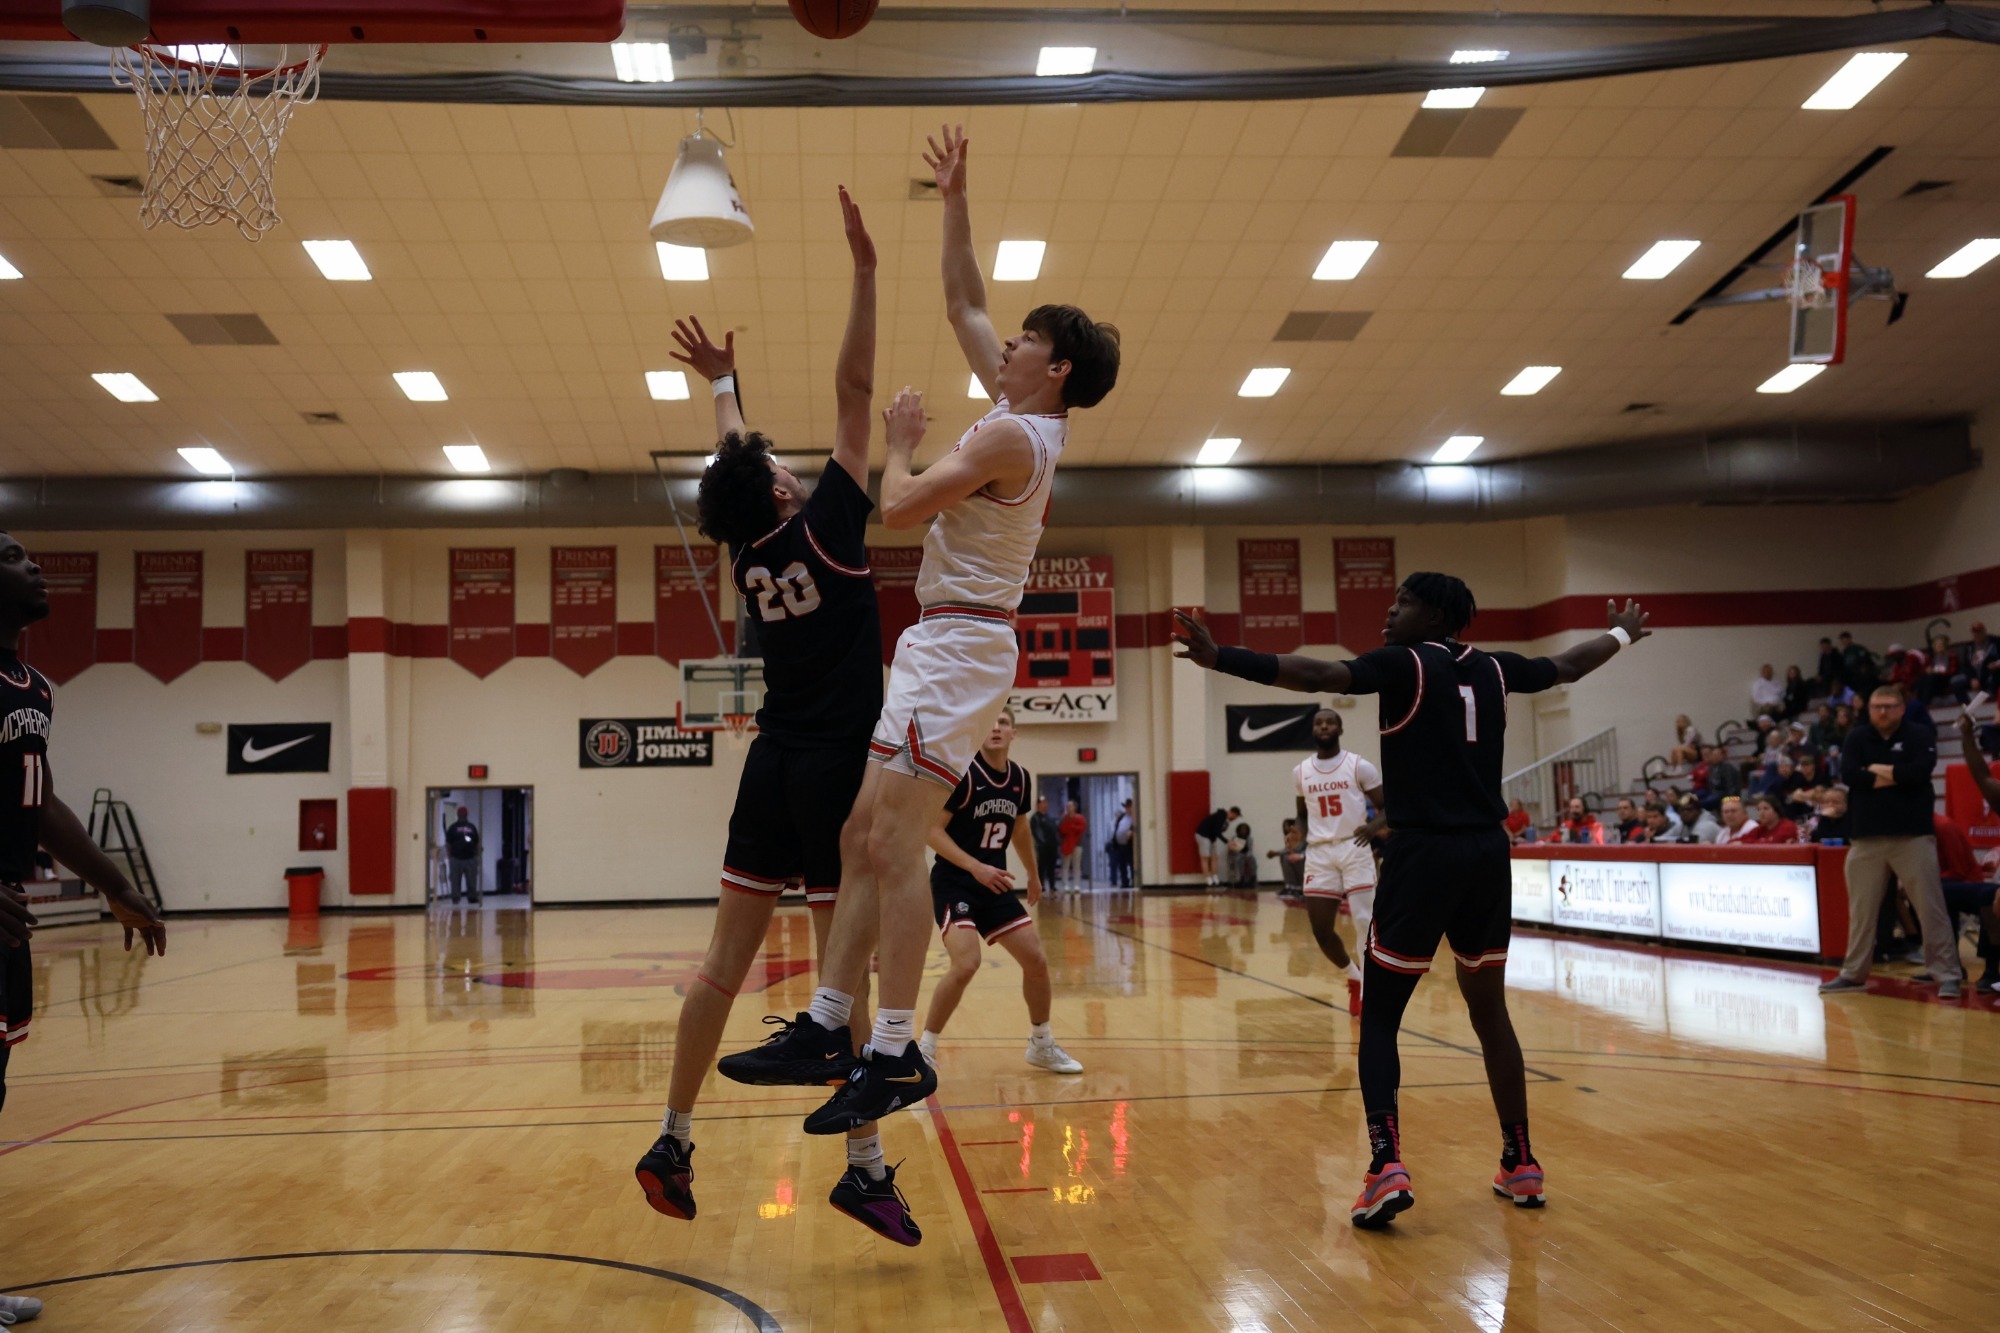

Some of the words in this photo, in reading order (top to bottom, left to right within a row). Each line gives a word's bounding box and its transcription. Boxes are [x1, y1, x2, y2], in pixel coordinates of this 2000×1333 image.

[1031, 557, 1091, 573] IENDS
[1025, 572, 1108, 588] VERSITY
[745, 561, 822, 622] 20
[1076, 616, 1108, 627] GUEST
[1007, 692, 1112, 715] EGACY
[1457, 684, 1478, 743] 1
[636, 744, 708, 763] JOHN'S
[22, 753, 43, 808] 11
[1308, 780, 1349, 794] FALCONS
[973, 798, 1018, 819] MCPHERSON
[1317, 794, 1343, 818] 15
[979, 821, 1008, 849] 12
